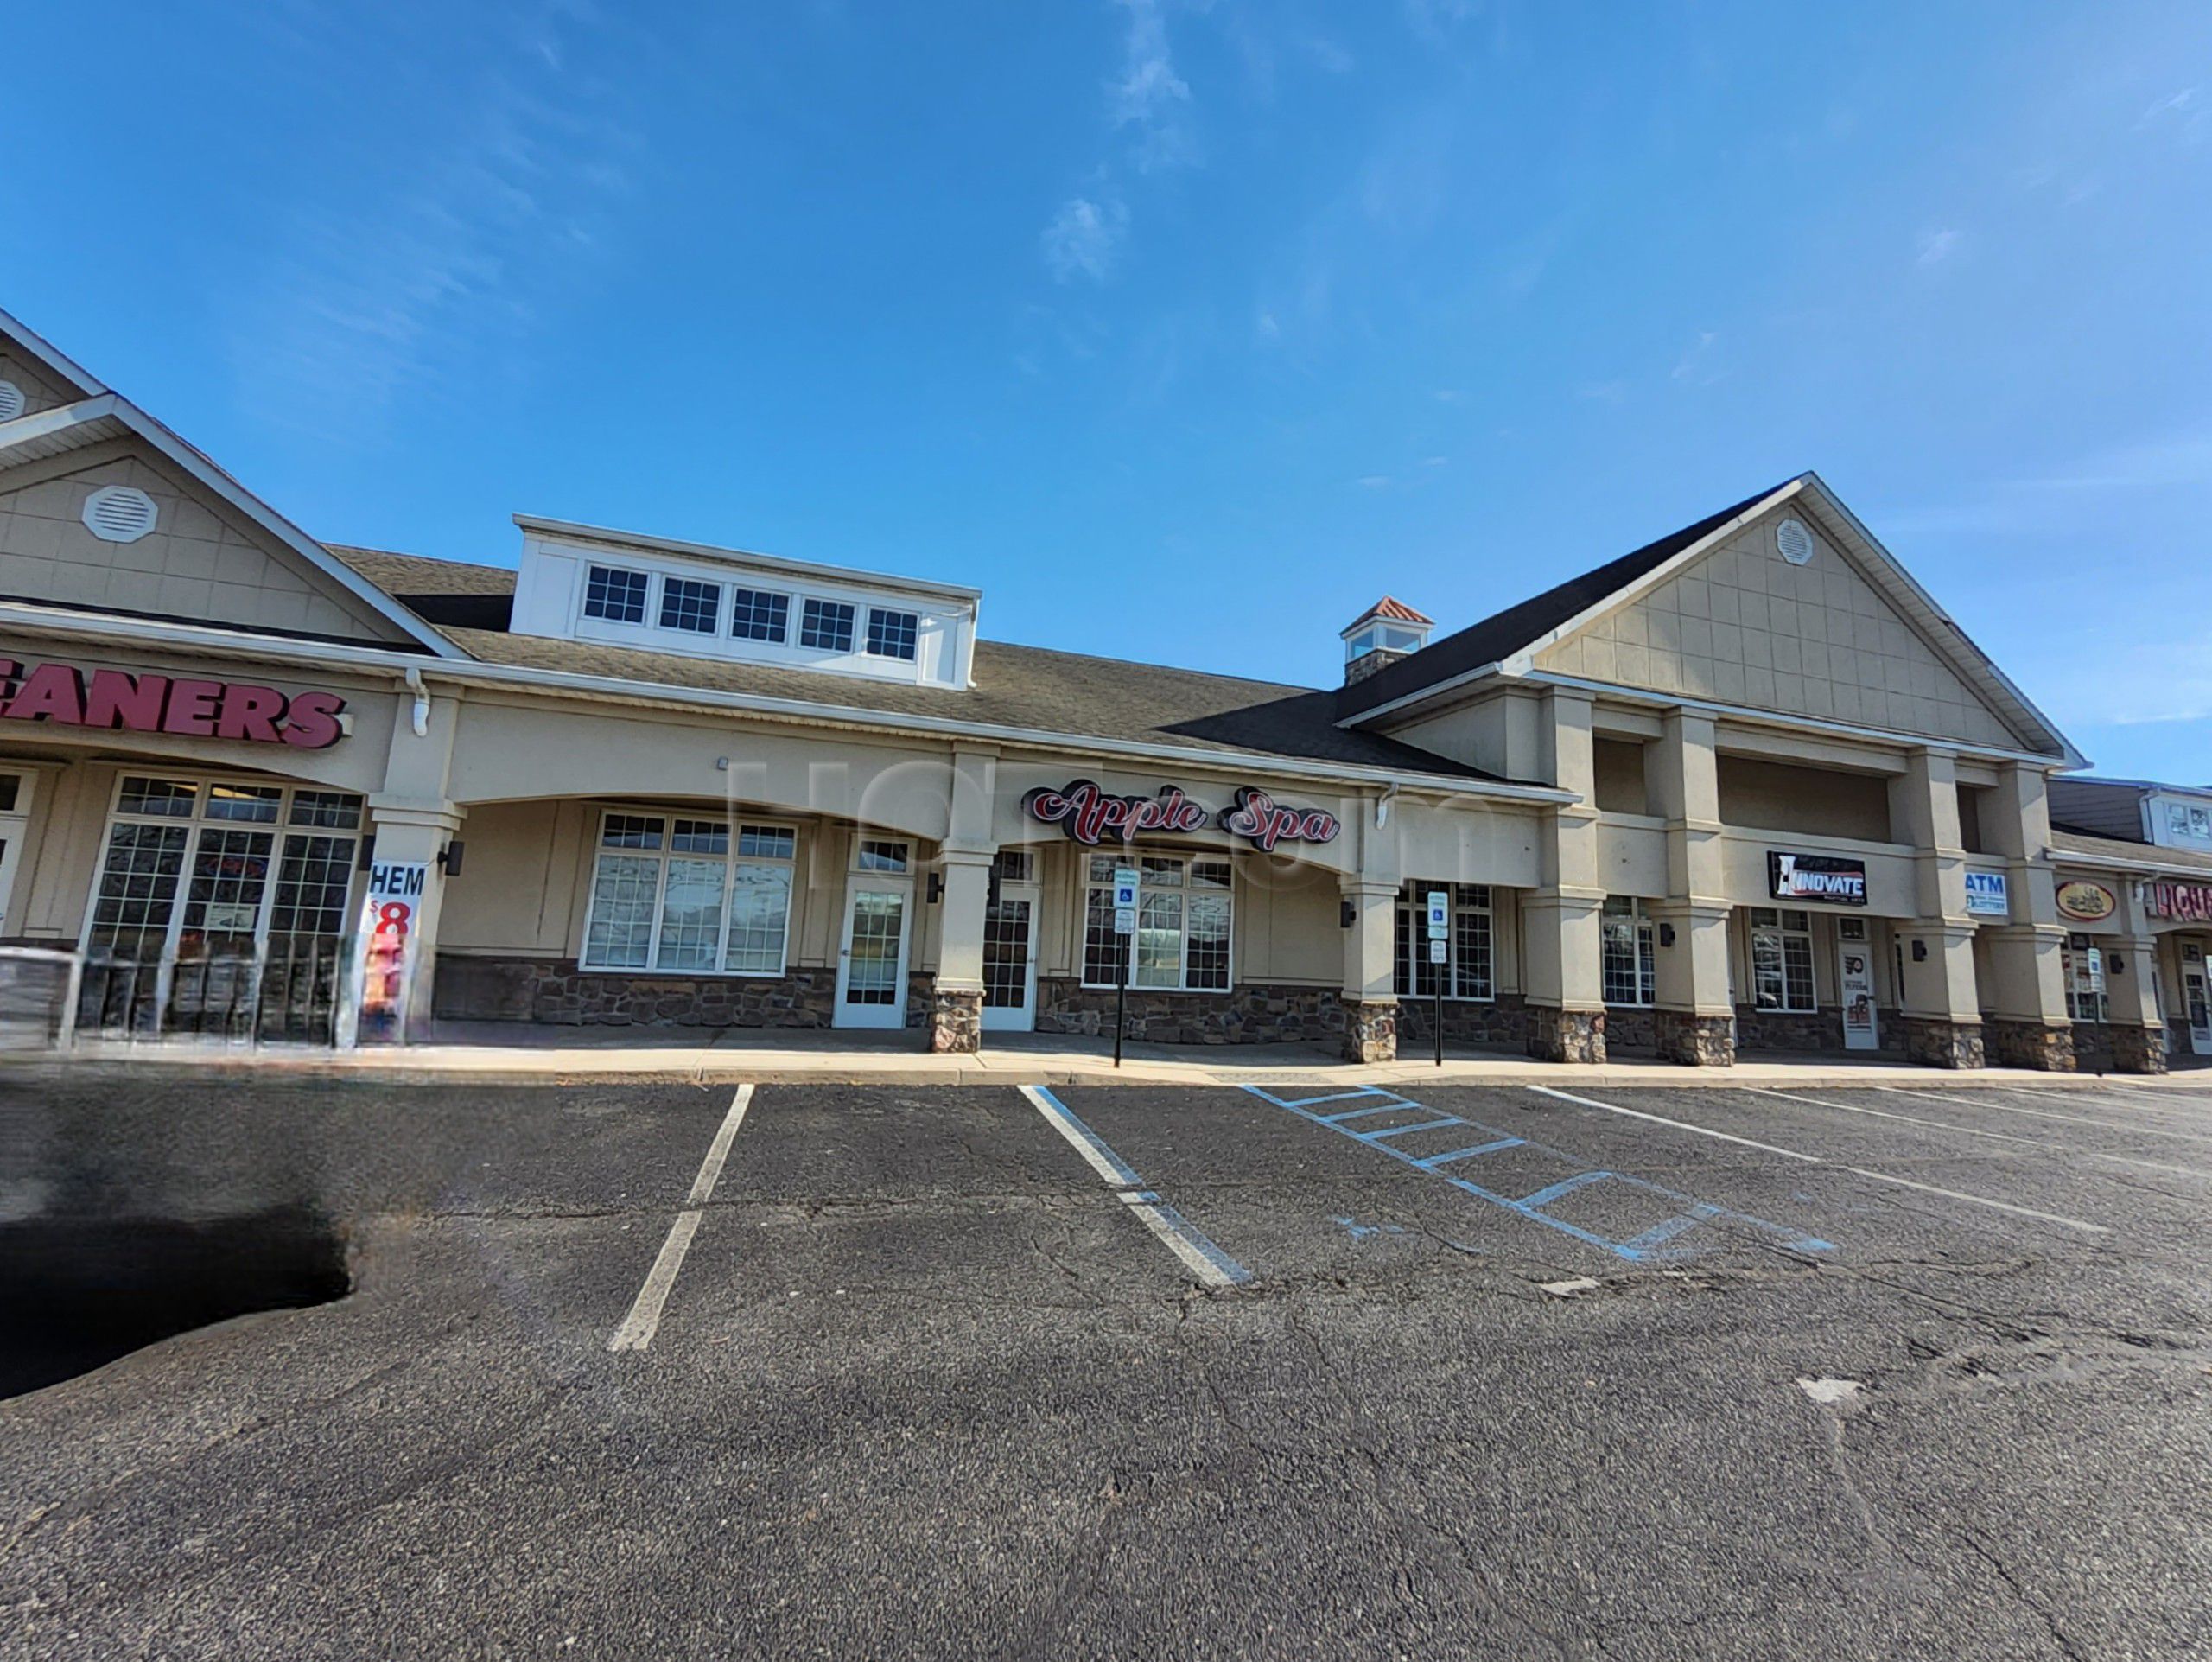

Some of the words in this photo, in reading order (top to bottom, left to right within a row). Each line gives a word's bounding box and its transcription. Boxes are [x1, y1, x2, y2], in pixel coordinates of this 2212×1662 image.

[1032, 783, 1208, 845] Apple
[1229, 791, 1341, 851] Spa
[369, 865, 426, 895] HEM
[1777, 856, 1864, 896] INNOVATE
[1965, 874, 2004, 893] ATM
